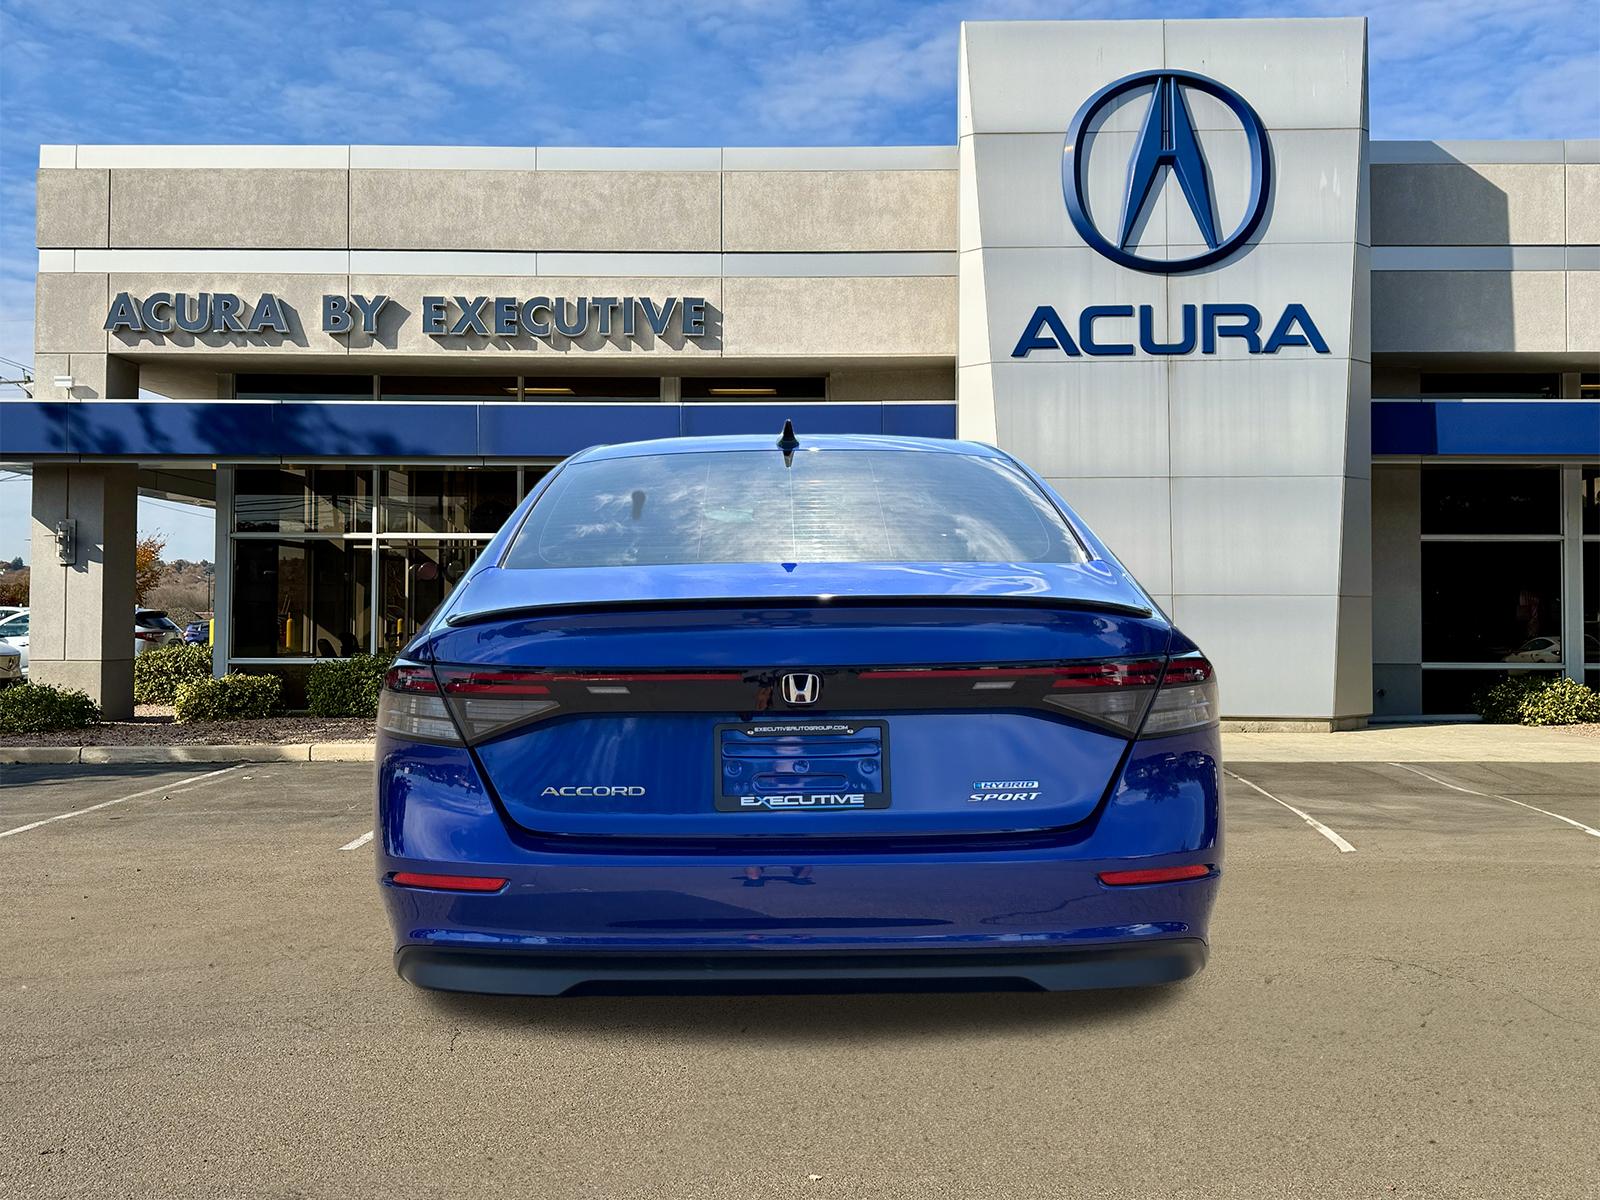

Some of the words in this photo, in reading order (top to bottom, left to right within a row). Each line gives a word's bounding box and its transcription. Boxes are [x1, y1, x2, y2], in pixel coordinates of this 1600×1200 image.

[104, 292, 290, 332] ACURA
[322, 295, 391, 333] BY
[422, 296, 706, 336] EXECUTIVE
[1011, 304, 1332, 357] ACURA
[541, 786, 646, 796] ACCORD
[980, 781, 1038, 789] HYBRID
[740, 794, 865, 808] EXECUTIVE
[968, 792, 1042, 801] SPORT
